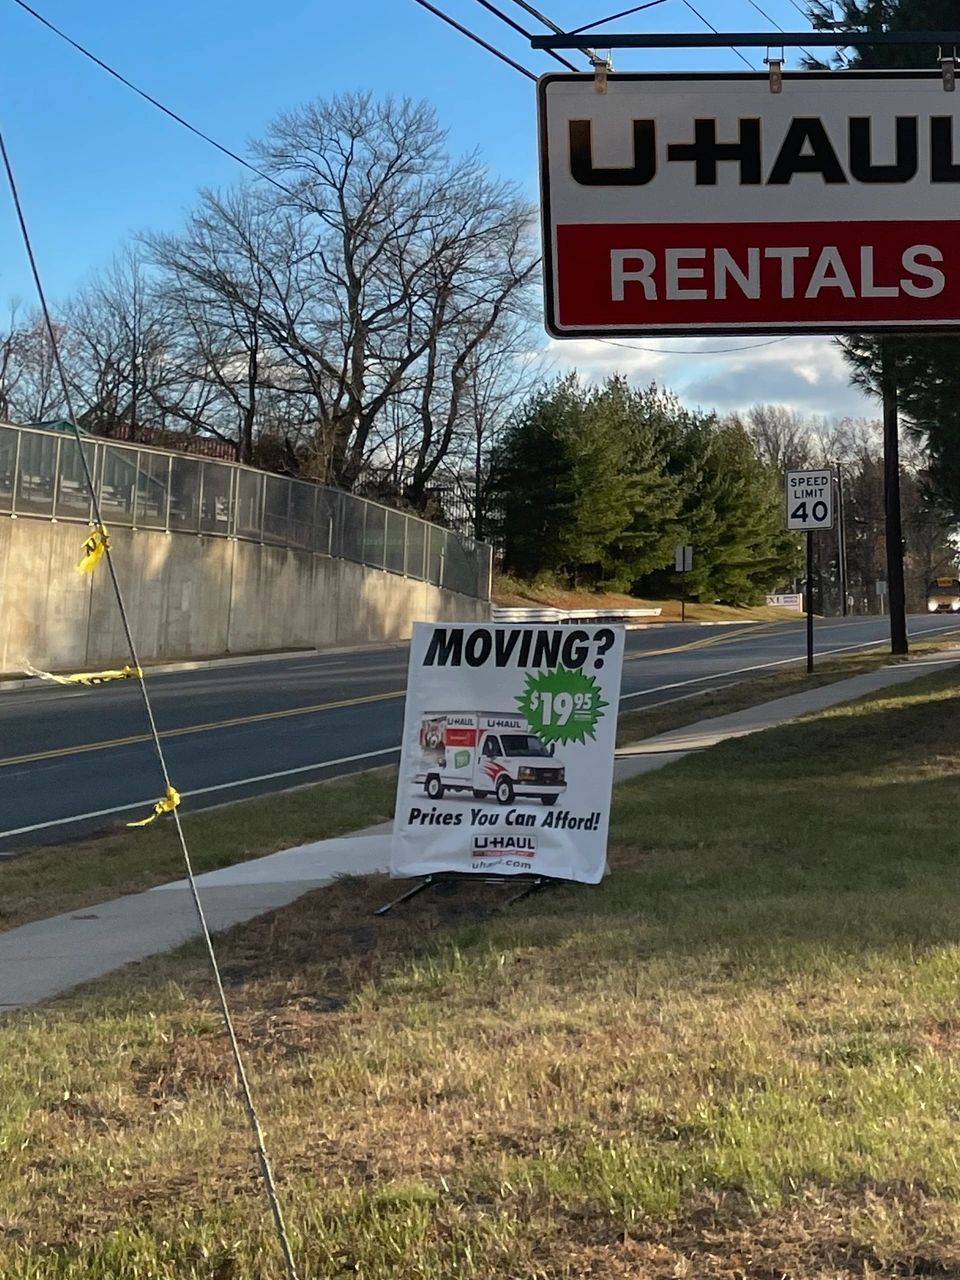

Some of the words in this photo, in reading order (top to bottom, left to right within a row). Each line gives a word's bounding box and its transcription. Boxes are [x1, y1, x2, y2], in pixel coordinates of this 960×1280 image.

[610, 244, 946, 301] RENTALS
[790, 477, 828, 488] SPEED
[793, 489, 824, 500] LIMIT
[790, 500, 828, 523] 40
[422, 628, 615, 670] MOVING?
[408, 807, 463, 826] Prices
[470, 808, 500, 827] You
[505, 809, 537, 827] Can
[541, 810, 601, 831] Afford!
